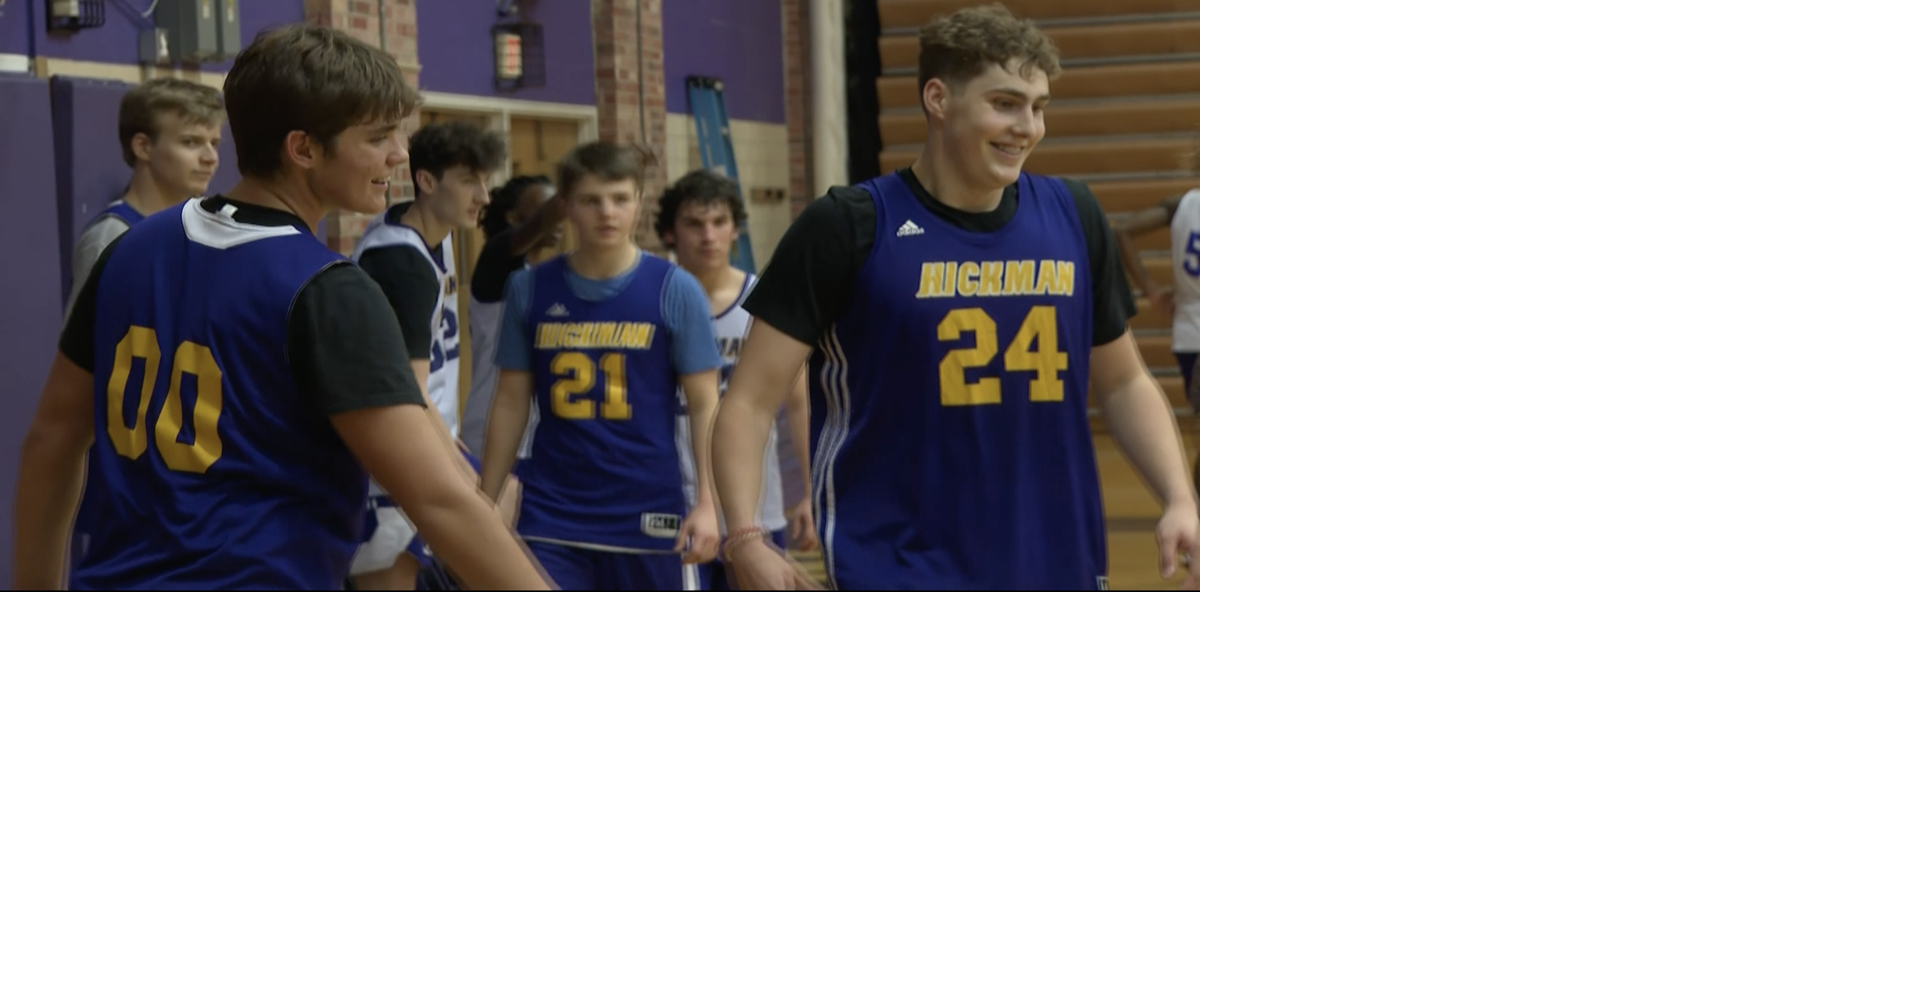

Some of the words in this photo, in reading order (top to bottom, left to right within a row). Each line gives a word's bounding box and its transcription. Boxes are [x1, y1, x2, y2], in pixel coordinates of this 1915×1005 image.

[915, 259, 1075, 299] HICKMAN
[549, 351, 633, 420] 21
[937, 305, 1068, 407] 24
[107, 325, 223, 474] 00
